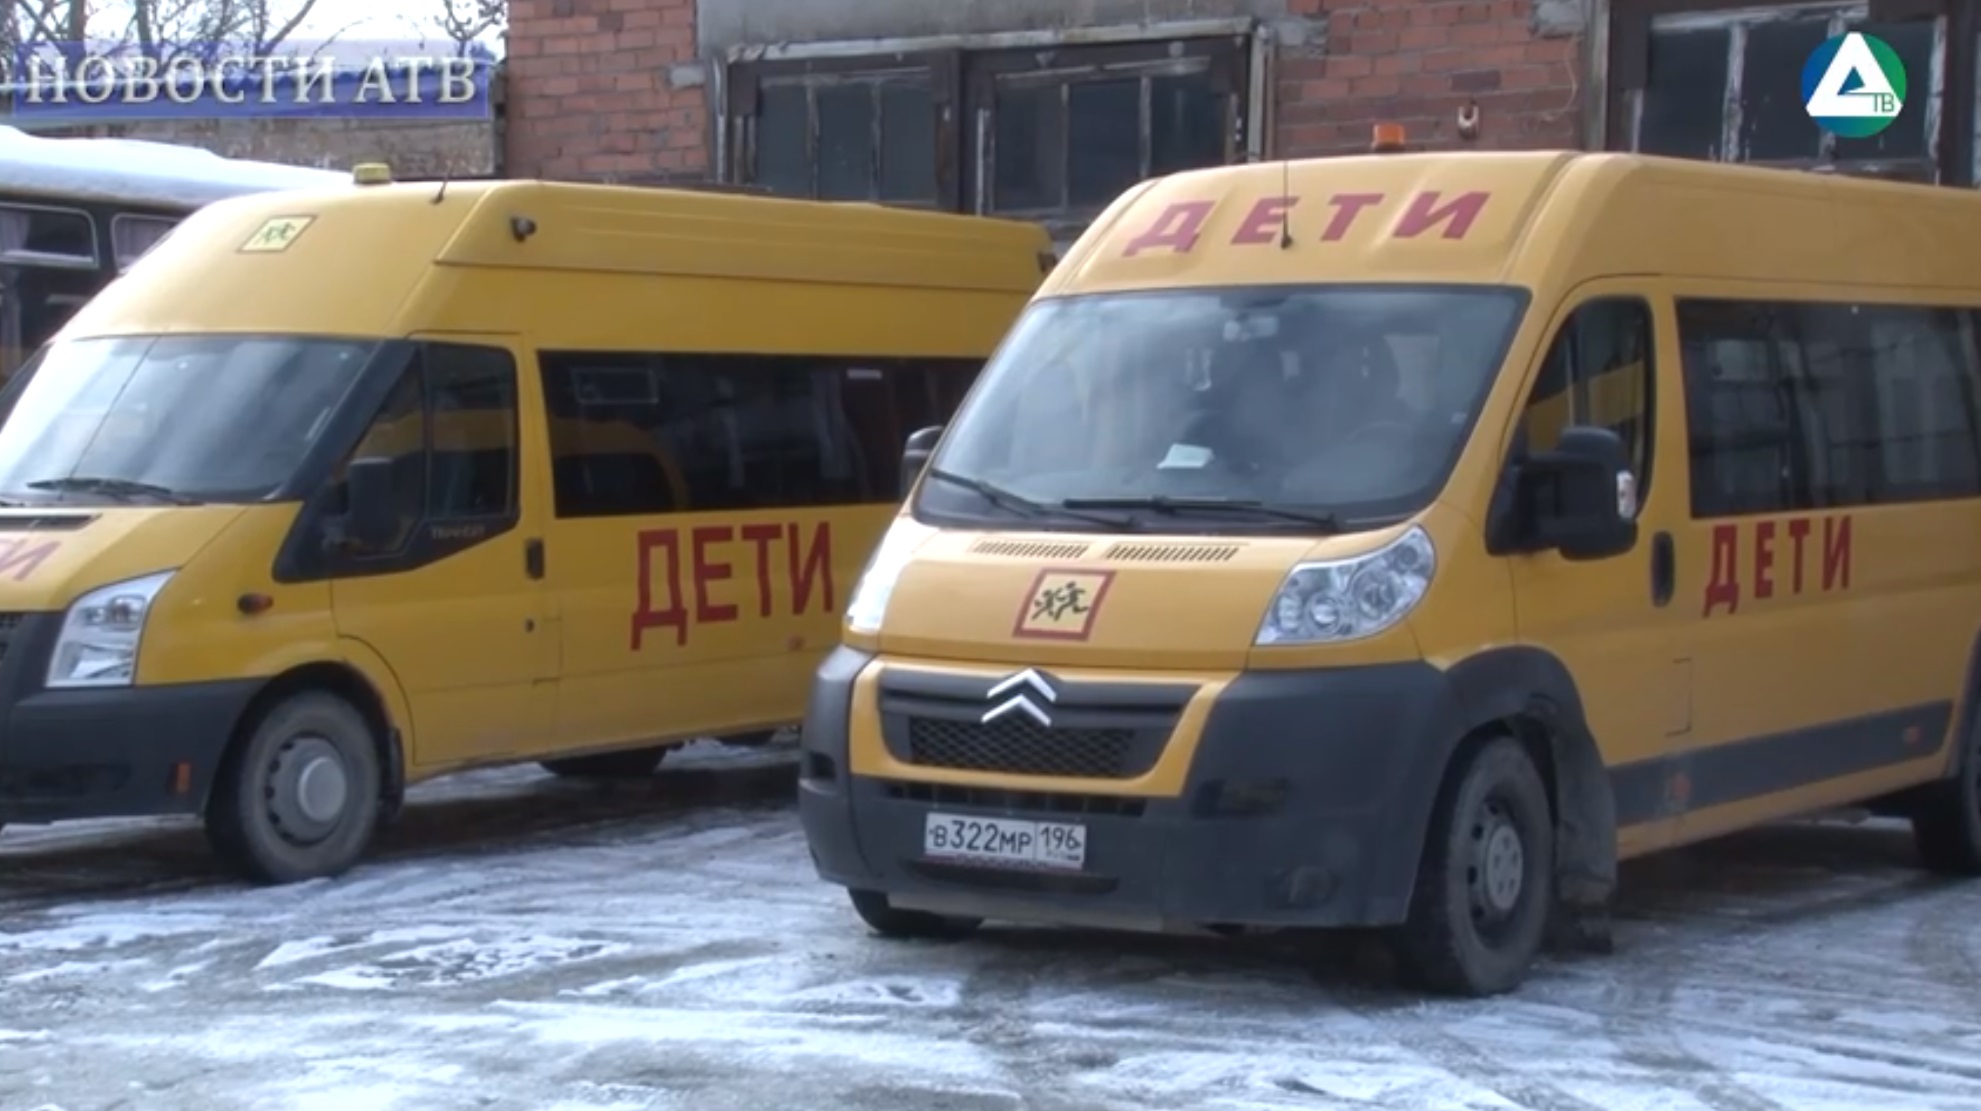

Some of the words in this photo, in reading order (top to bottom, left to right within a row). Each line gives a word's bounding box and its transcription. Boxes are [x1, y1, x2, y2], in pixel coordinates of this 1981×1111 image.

[1121, 191, 1491, 258] ДЕТИ
[630, 520, 834, 652] ДЕТИ
[1702, 514, 1852, 619] ДЕТИ
[1039, 825, 1080, 850] 196
